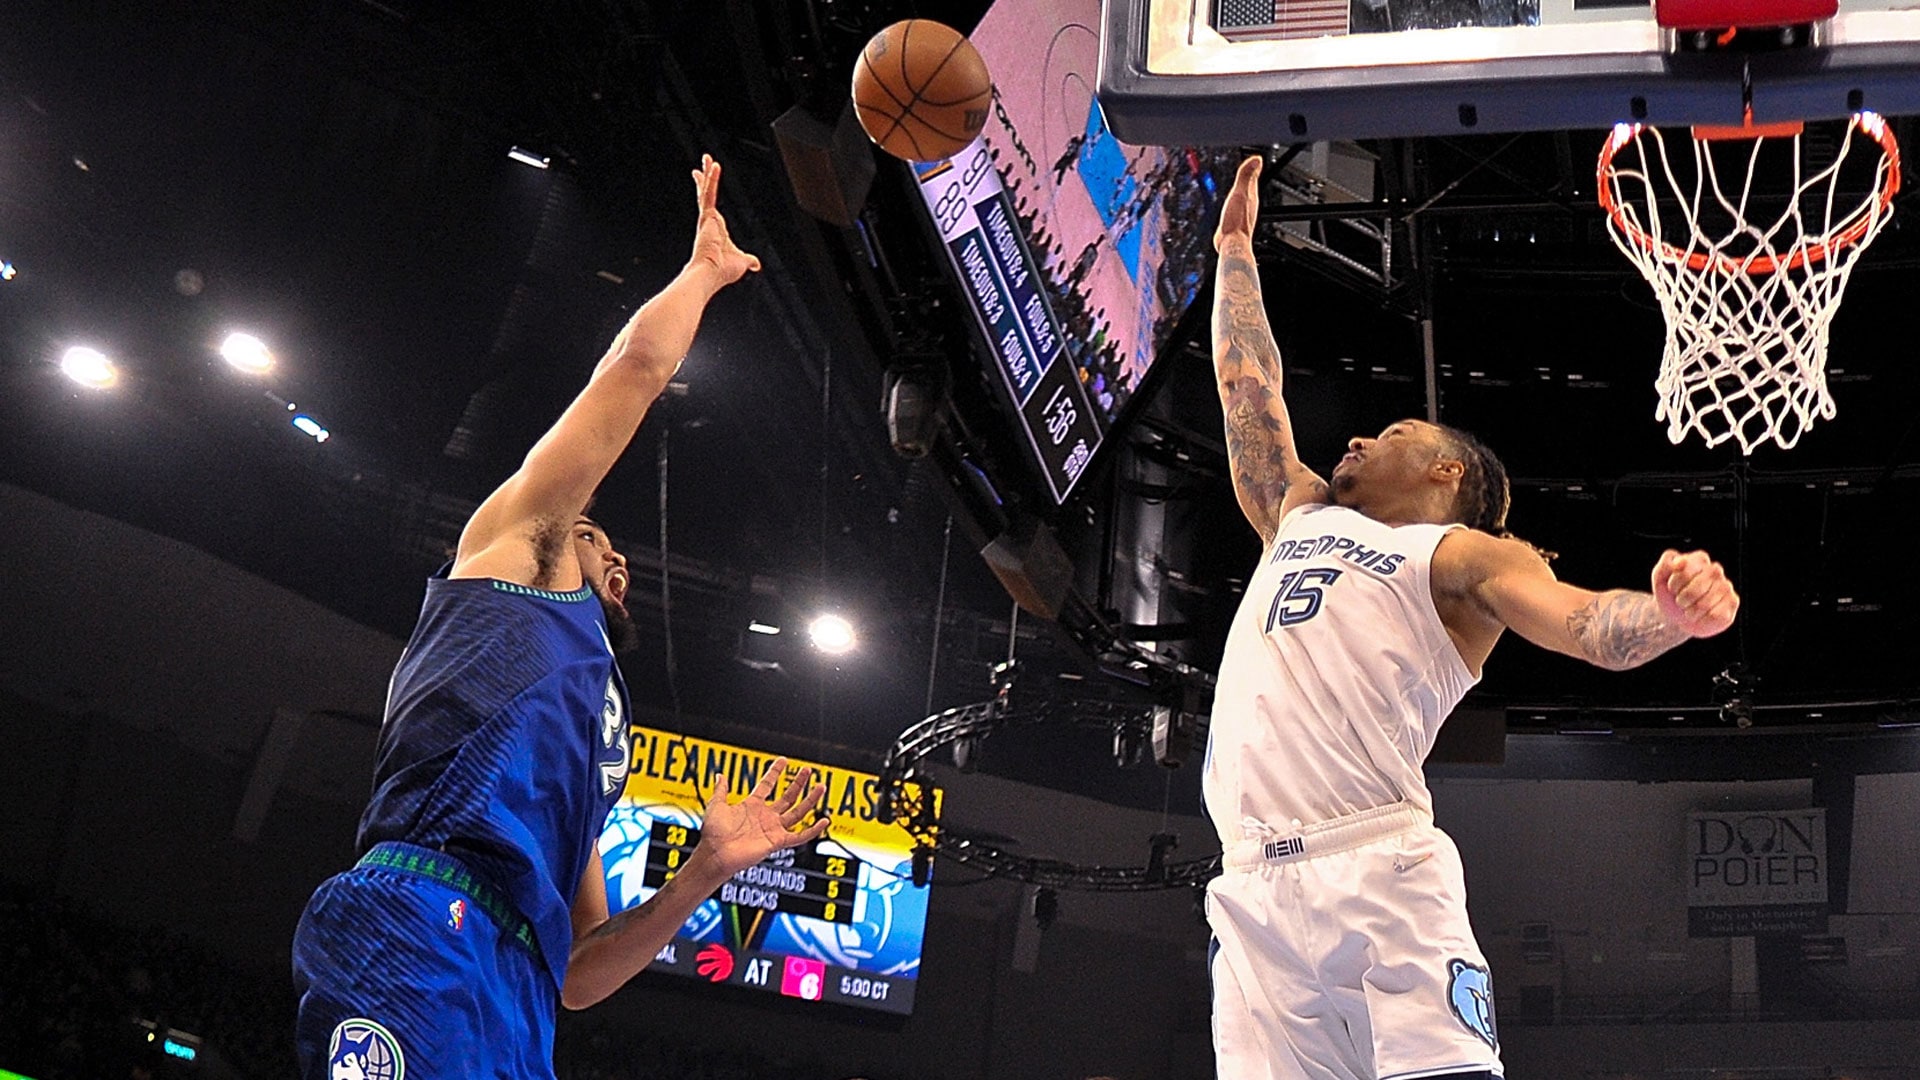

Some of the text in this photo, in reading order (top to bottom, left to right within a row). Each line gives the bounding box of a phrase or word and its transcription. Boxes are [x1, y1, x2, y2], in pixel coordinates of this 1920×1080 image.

[935, 181, 967, 235] 89
[1042, 384, 1077, 445] 1:56
[1270, 535, 1406, 576] MEMPHIS
[1265, 567, 1344, 635] 15
[826, 857, 847, 877] 25
[721, 882, 779, 911] BLOCKS
[744, 957, 773, 986] AT
